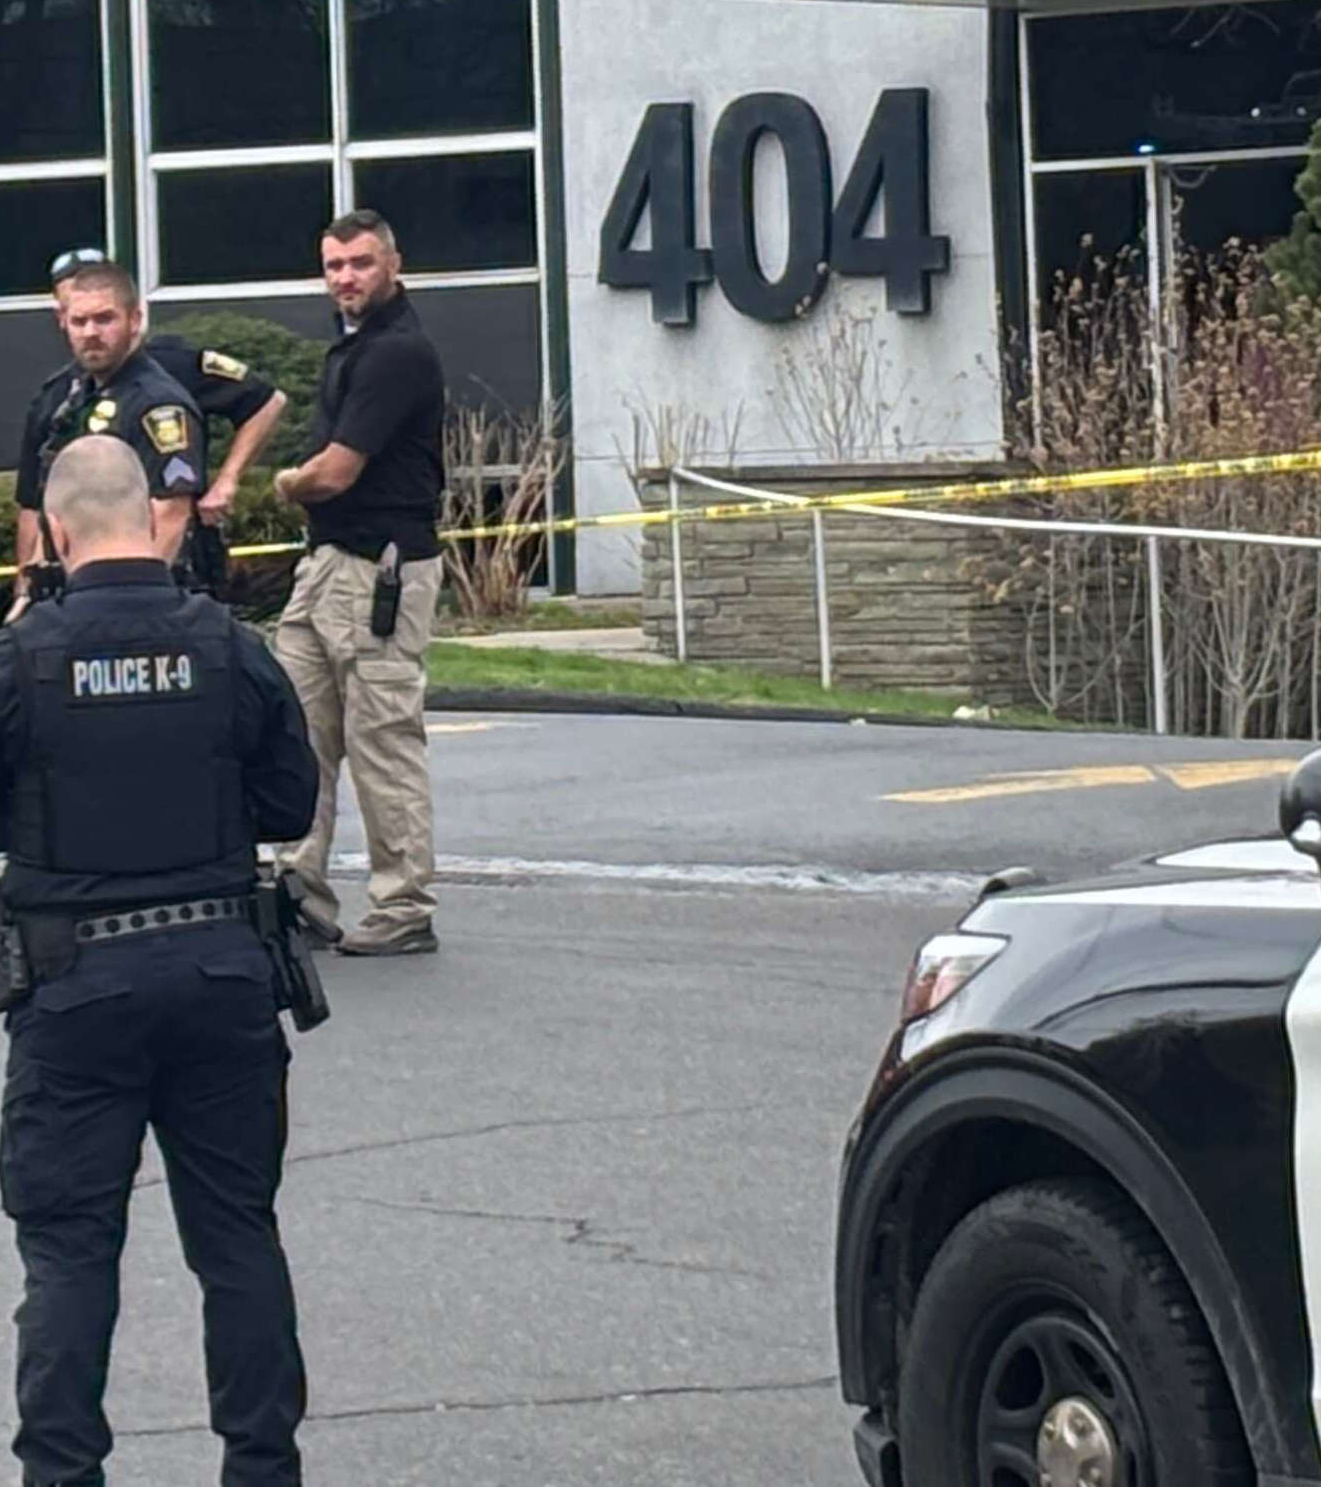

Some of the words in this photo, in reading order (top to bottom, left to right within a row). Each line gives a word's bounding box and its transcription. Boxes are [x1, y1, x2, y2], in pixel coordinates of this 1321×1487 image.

[597, 86, 951, 328] 404
[73, 657, 151, 697] POLICE
[154, 654, 192, 691] K-9
